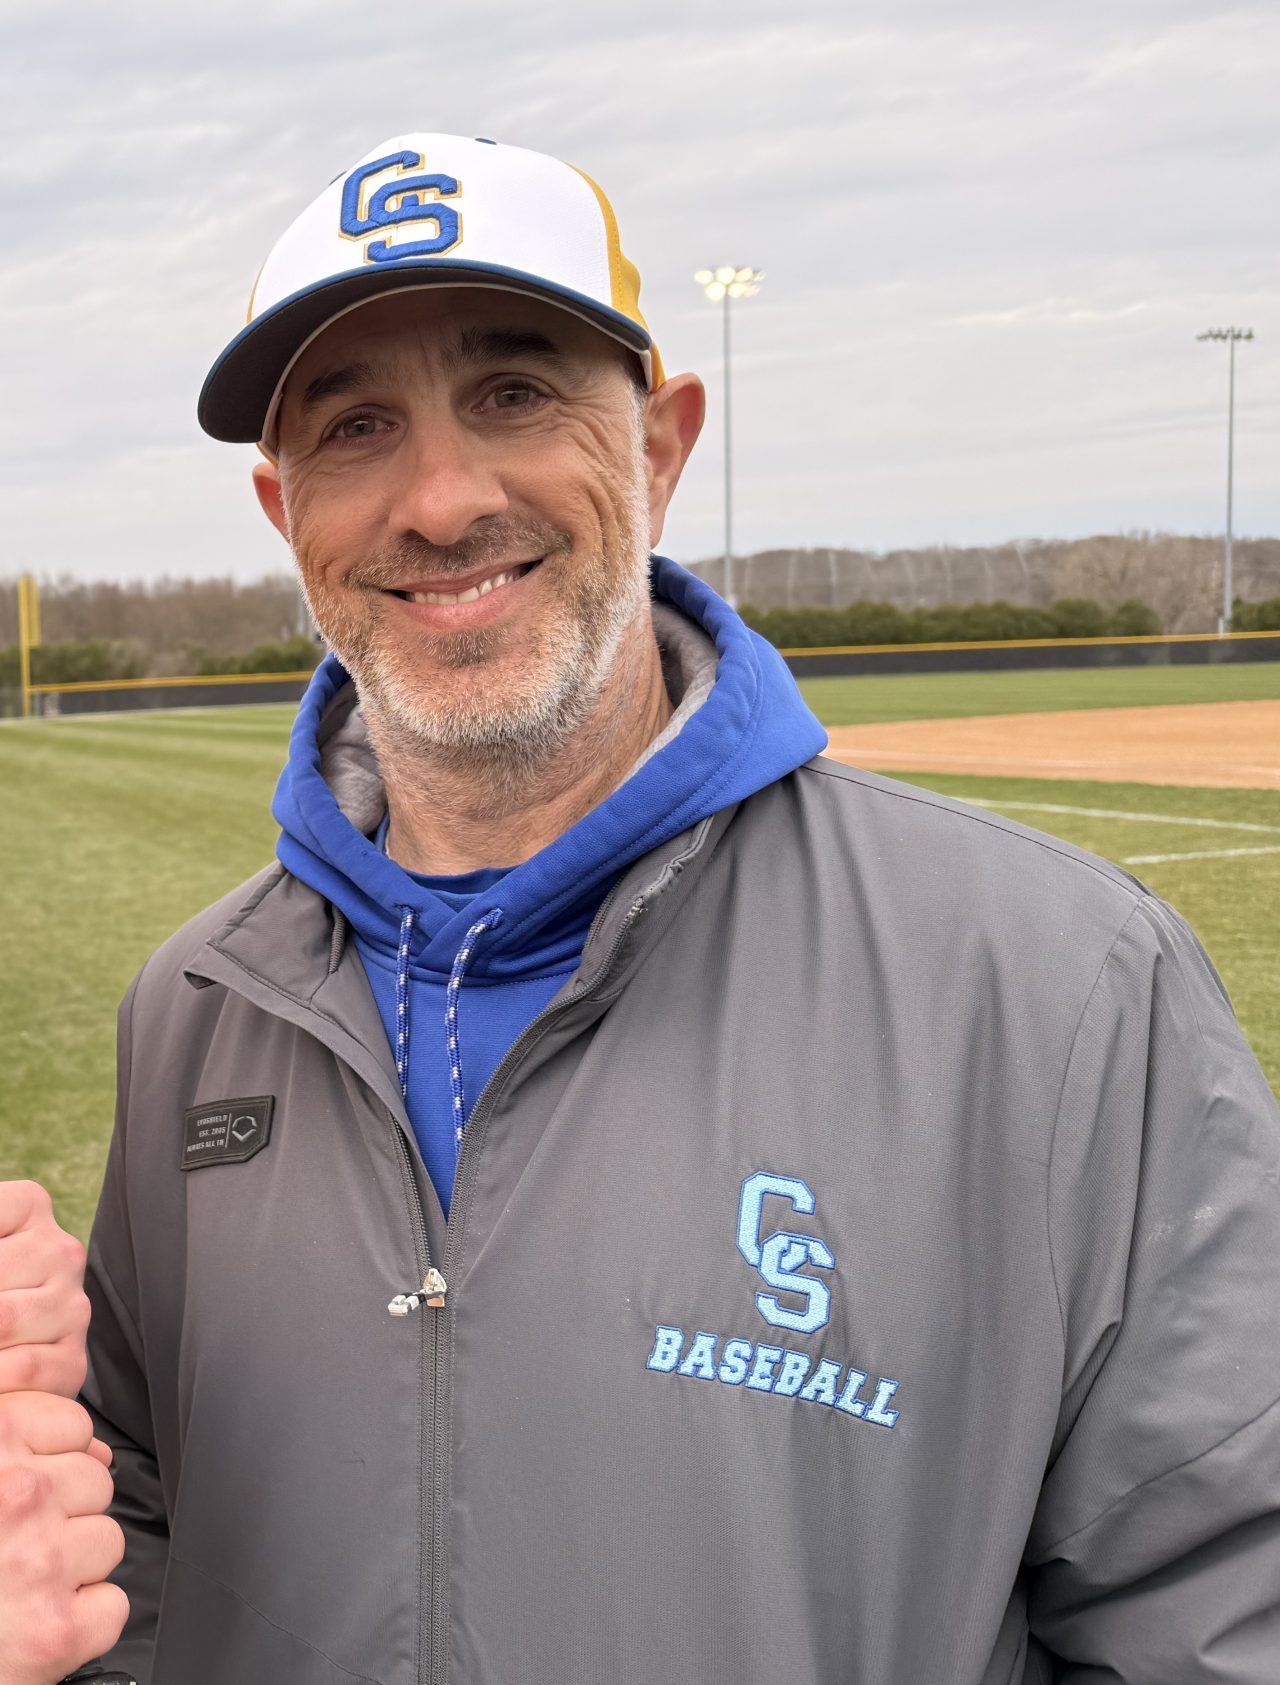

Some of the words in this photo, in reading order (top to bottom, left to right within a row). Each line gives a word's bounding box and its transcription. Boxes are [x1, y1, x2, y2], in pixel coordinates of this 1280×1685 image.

[338, 150, 464, 264] CS
[736, 1171, 835, 1334] CS
[646, 1325, 900, 1428] BASEBALL
